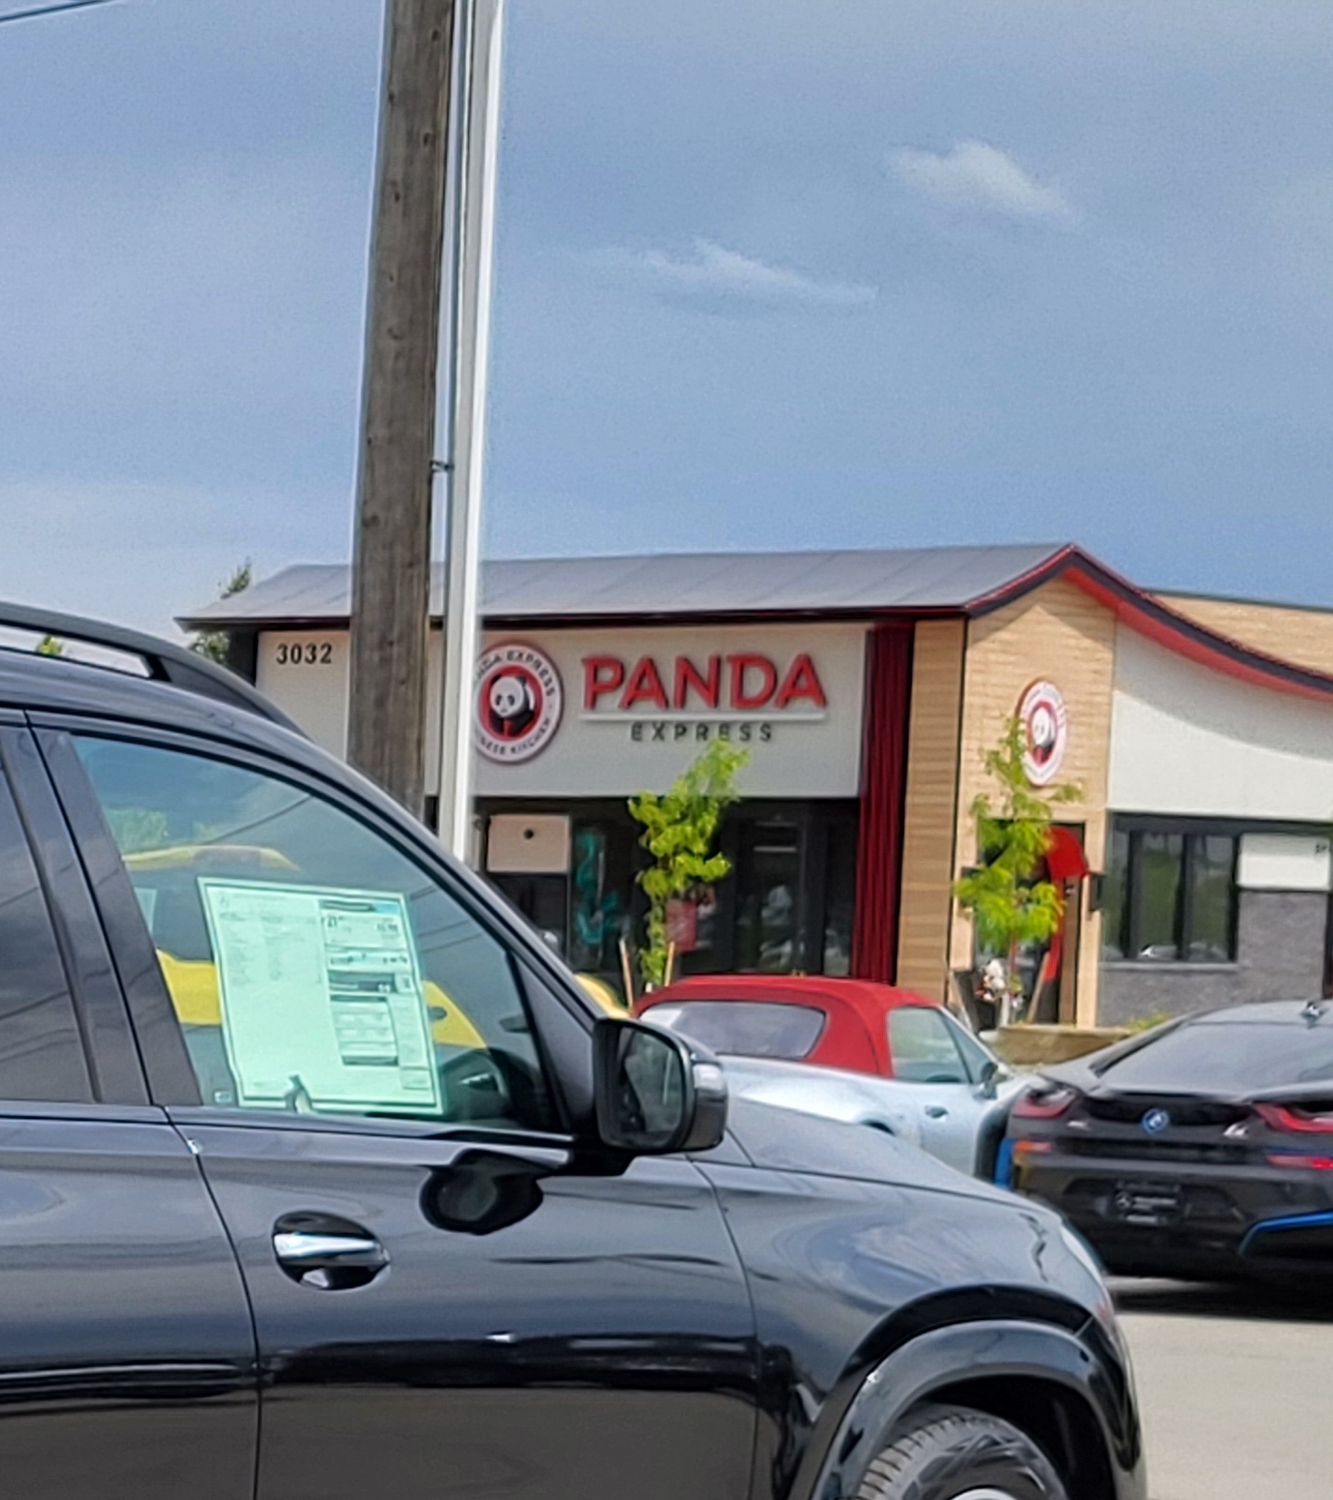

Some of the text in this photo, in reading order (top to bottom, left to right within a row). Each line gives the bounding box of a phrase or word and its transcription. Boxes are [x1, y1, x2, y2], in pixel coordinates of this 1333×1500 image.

[276, 642, 332, 665] 3032
[581, 653, 827, 710] PANDA
[630, 721, 773, 742] EXPRESS
